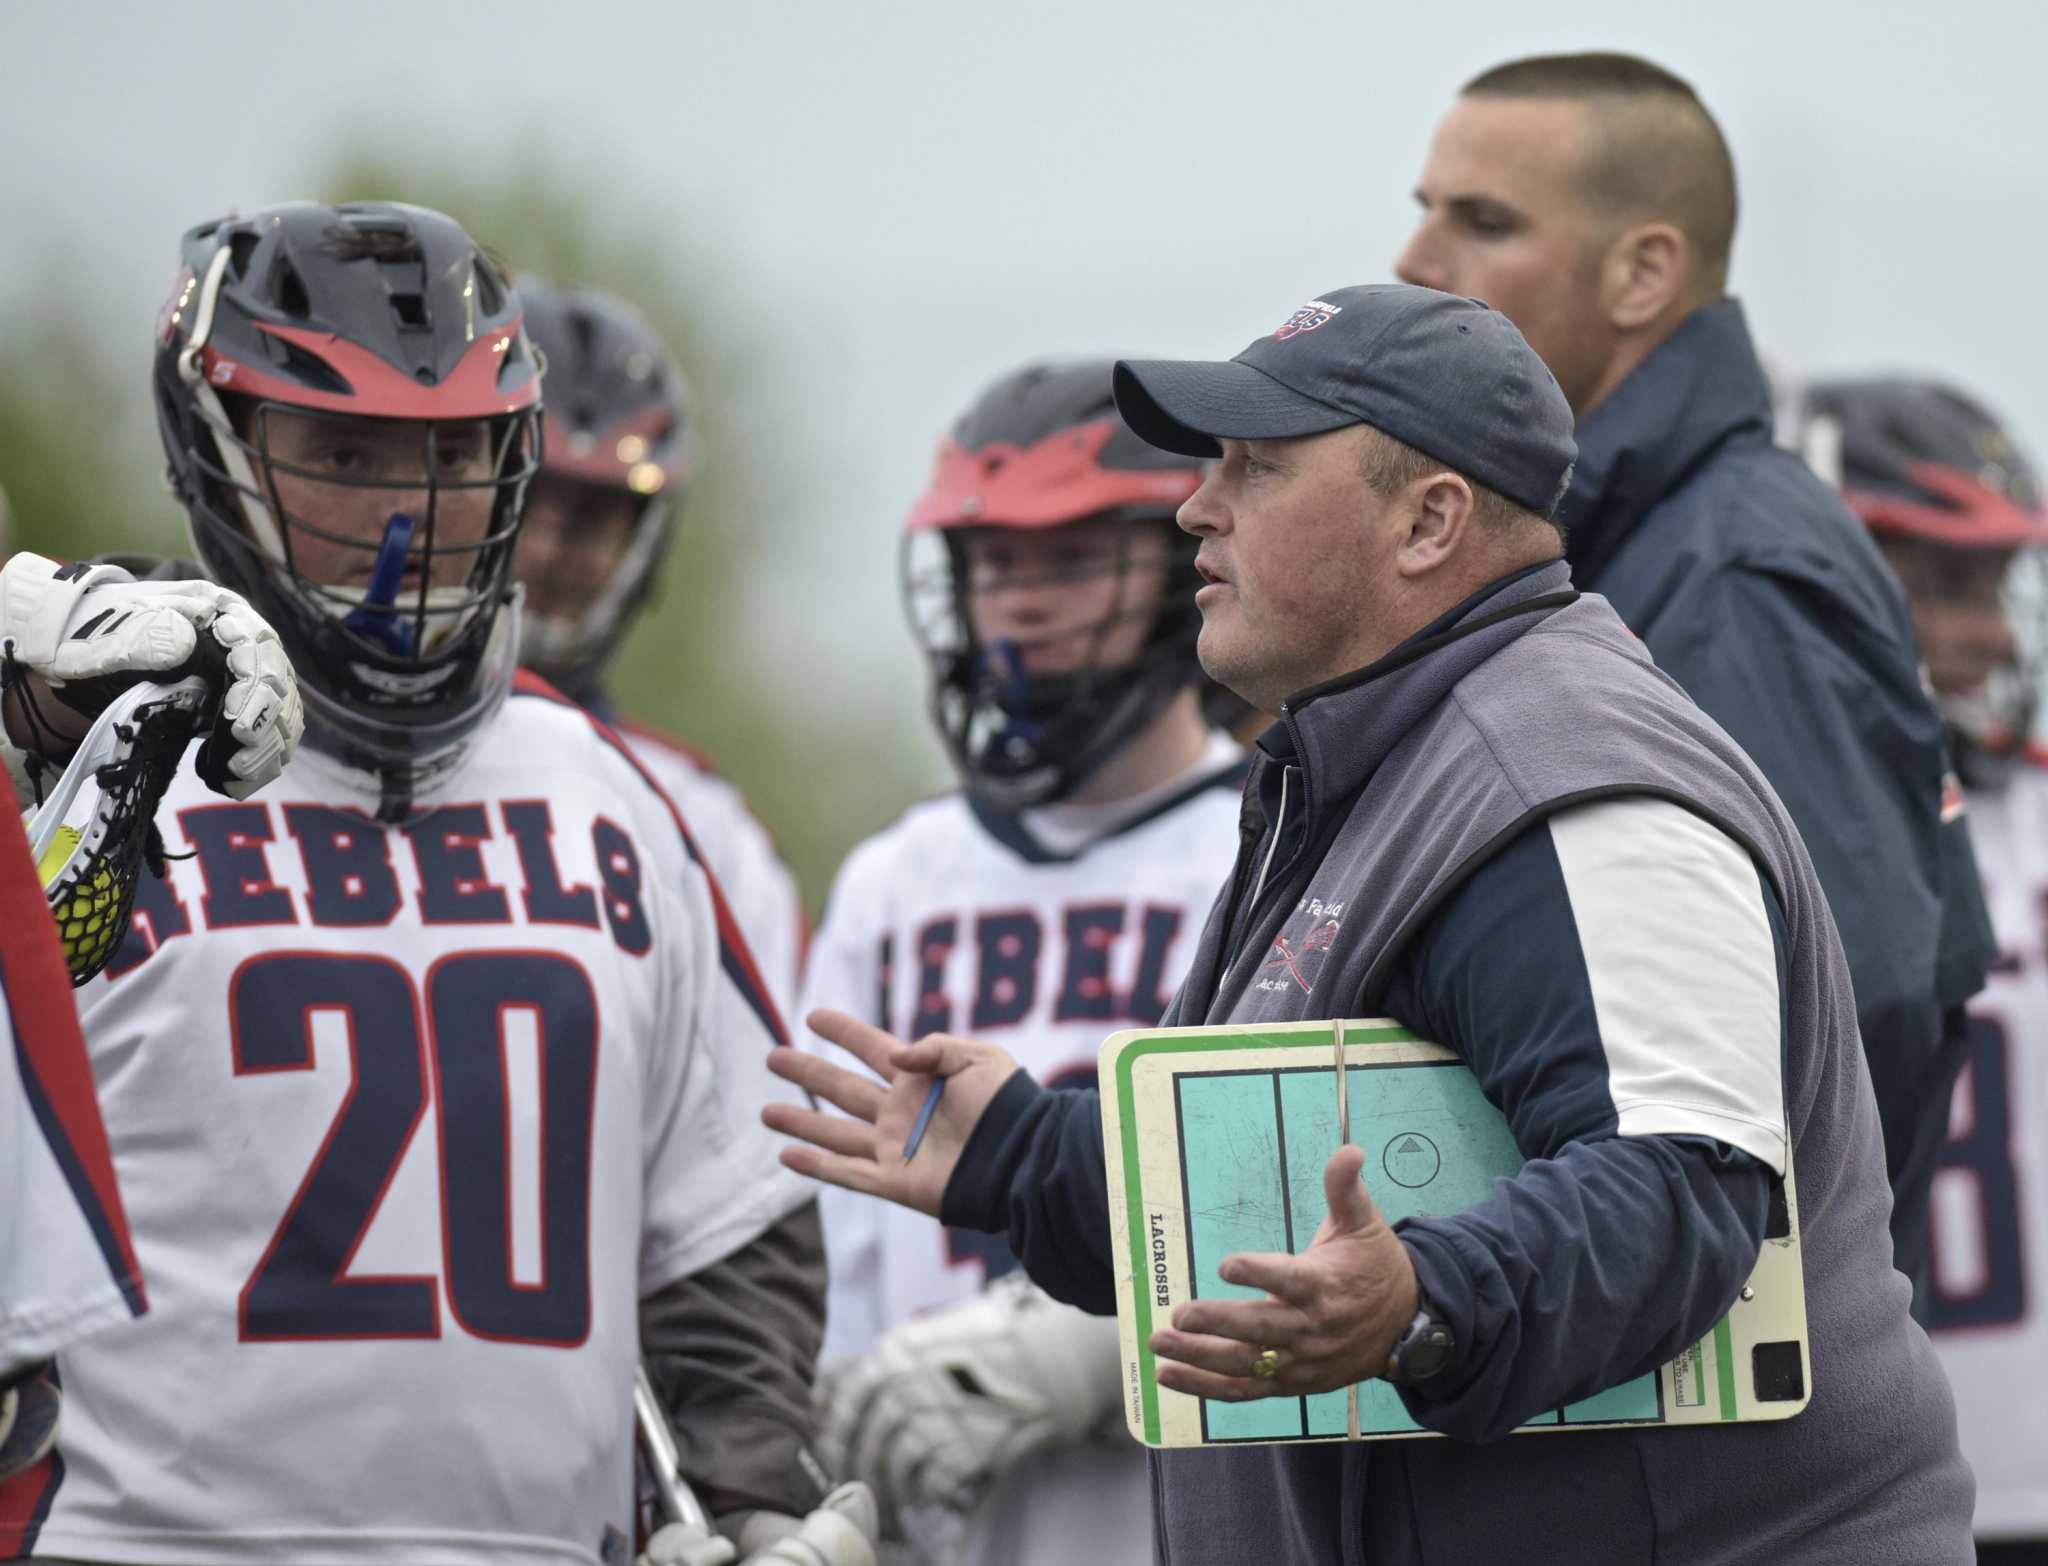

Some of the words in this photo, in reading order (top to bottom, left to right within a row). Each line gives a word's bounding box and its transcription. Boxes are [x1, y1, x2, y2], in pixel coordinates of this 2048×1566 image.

[878, 898, 1184, 1045] EBEL
[228, 948, 602, 1351] 20
[1150, 1213, 1170, 1307] LACROSSE
